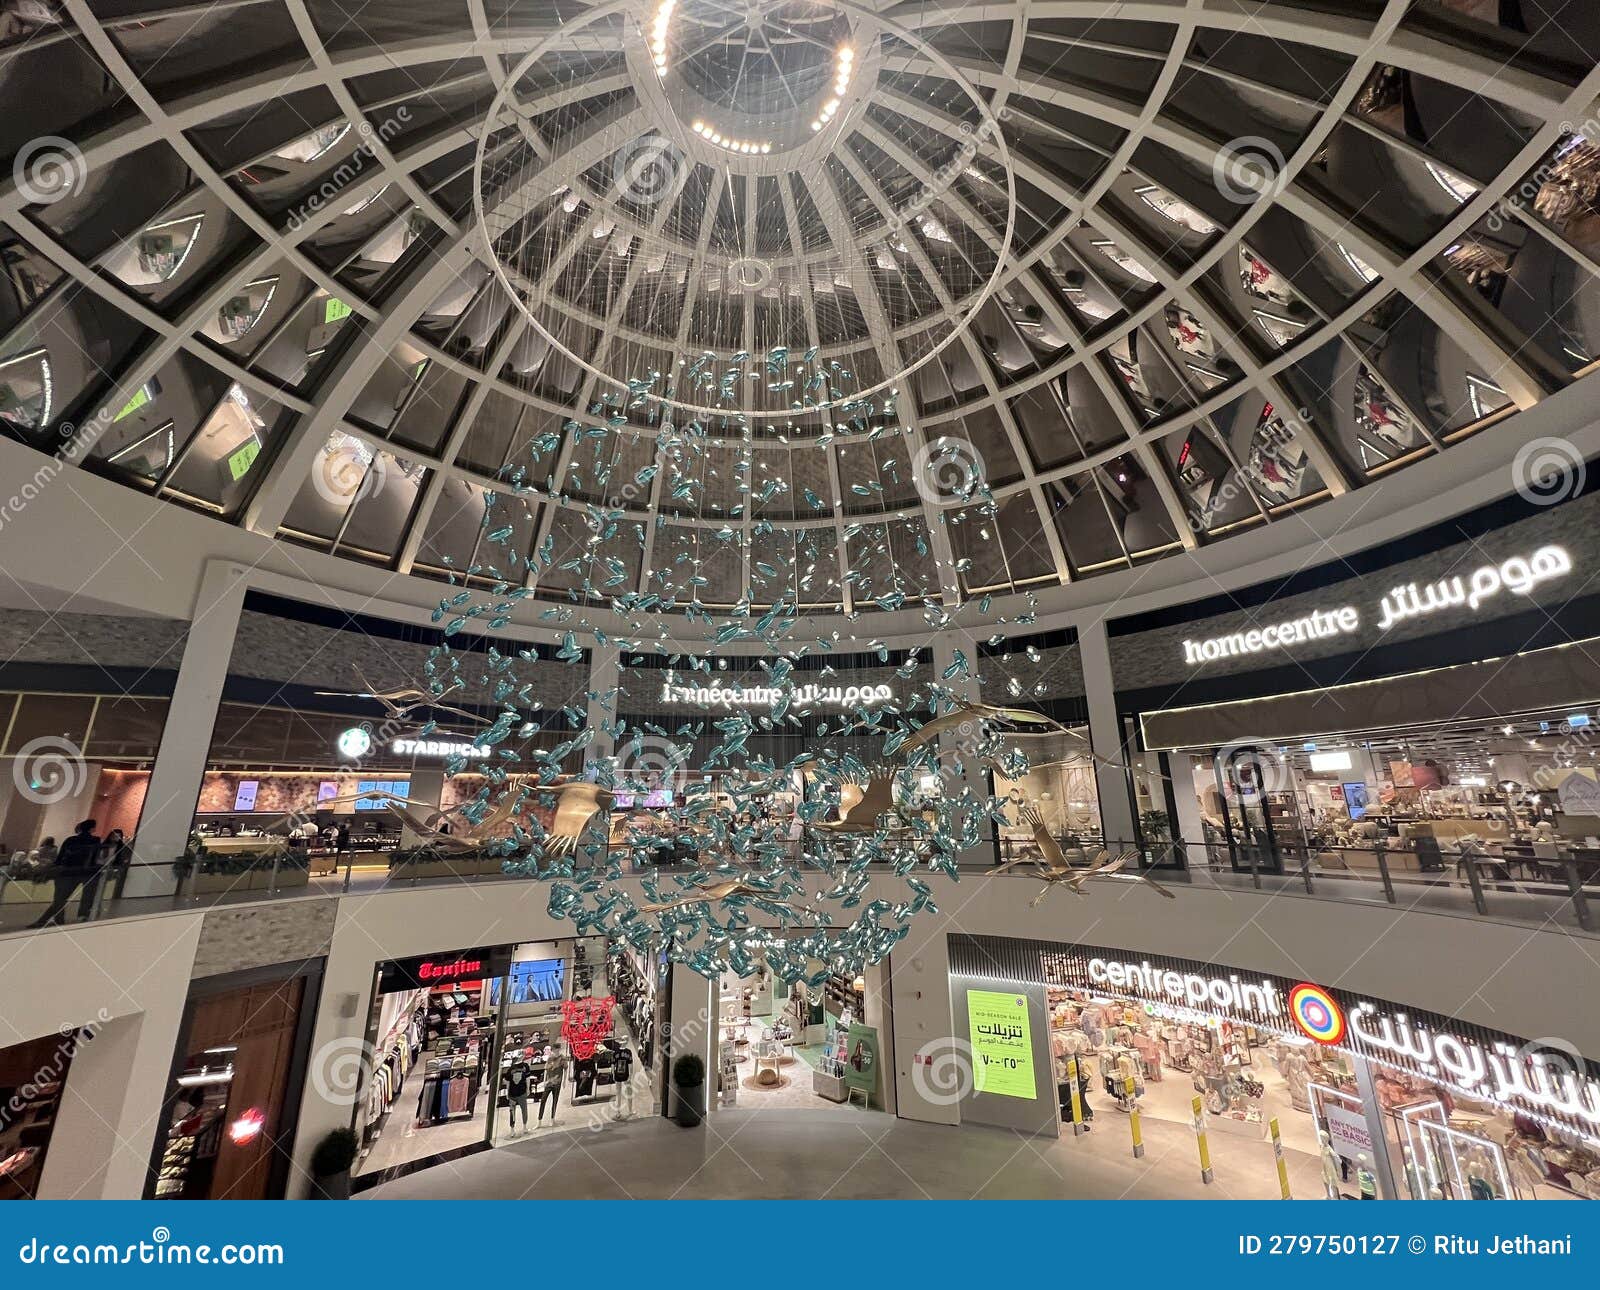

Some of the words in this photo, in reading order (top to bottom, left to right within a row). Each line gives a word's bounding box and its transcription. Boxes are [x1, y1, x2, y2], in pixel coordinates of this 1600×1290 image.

[1377, 581, 1465, 629] سنتر
[1469, 544, 1572, 610] هوم
[1184, 604, 1359, 664] homecentre
[1088, 958, 1281, 1017] centrepoint
[977, 1023, 1022, 1040] تنزيلات
